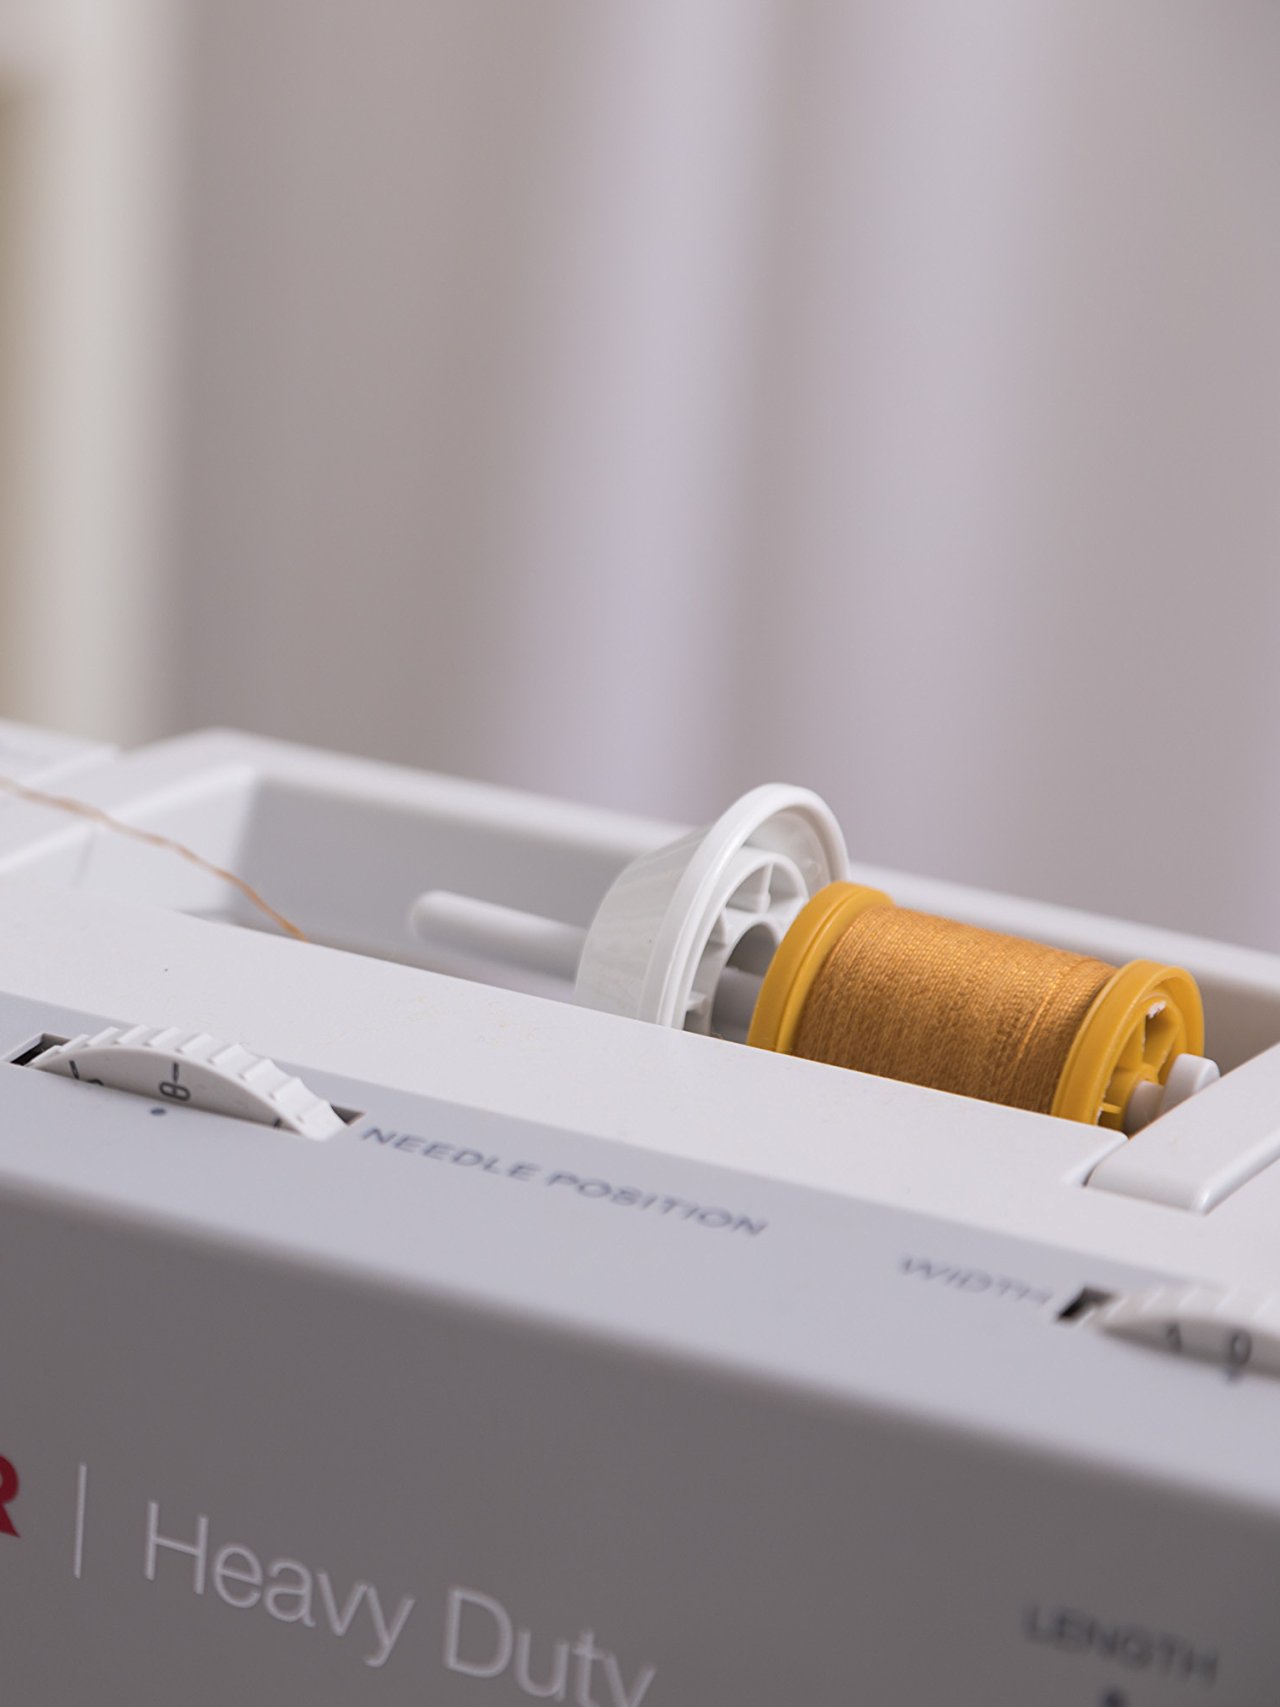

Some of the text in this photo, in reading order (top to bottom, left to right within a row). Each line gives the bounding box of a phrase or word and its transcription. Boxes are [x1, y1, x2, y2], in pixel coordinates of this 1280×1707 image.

[361, 1126, 769, 1236] NEEDLE POSITION
[898, 1254, 1054, 1304] WIDTH
[144, 1500, 416, 1668] Heavy
[445, 1586, 658, 1707] Duty
[1021, 1603, 1219, 1688] LENGTH
